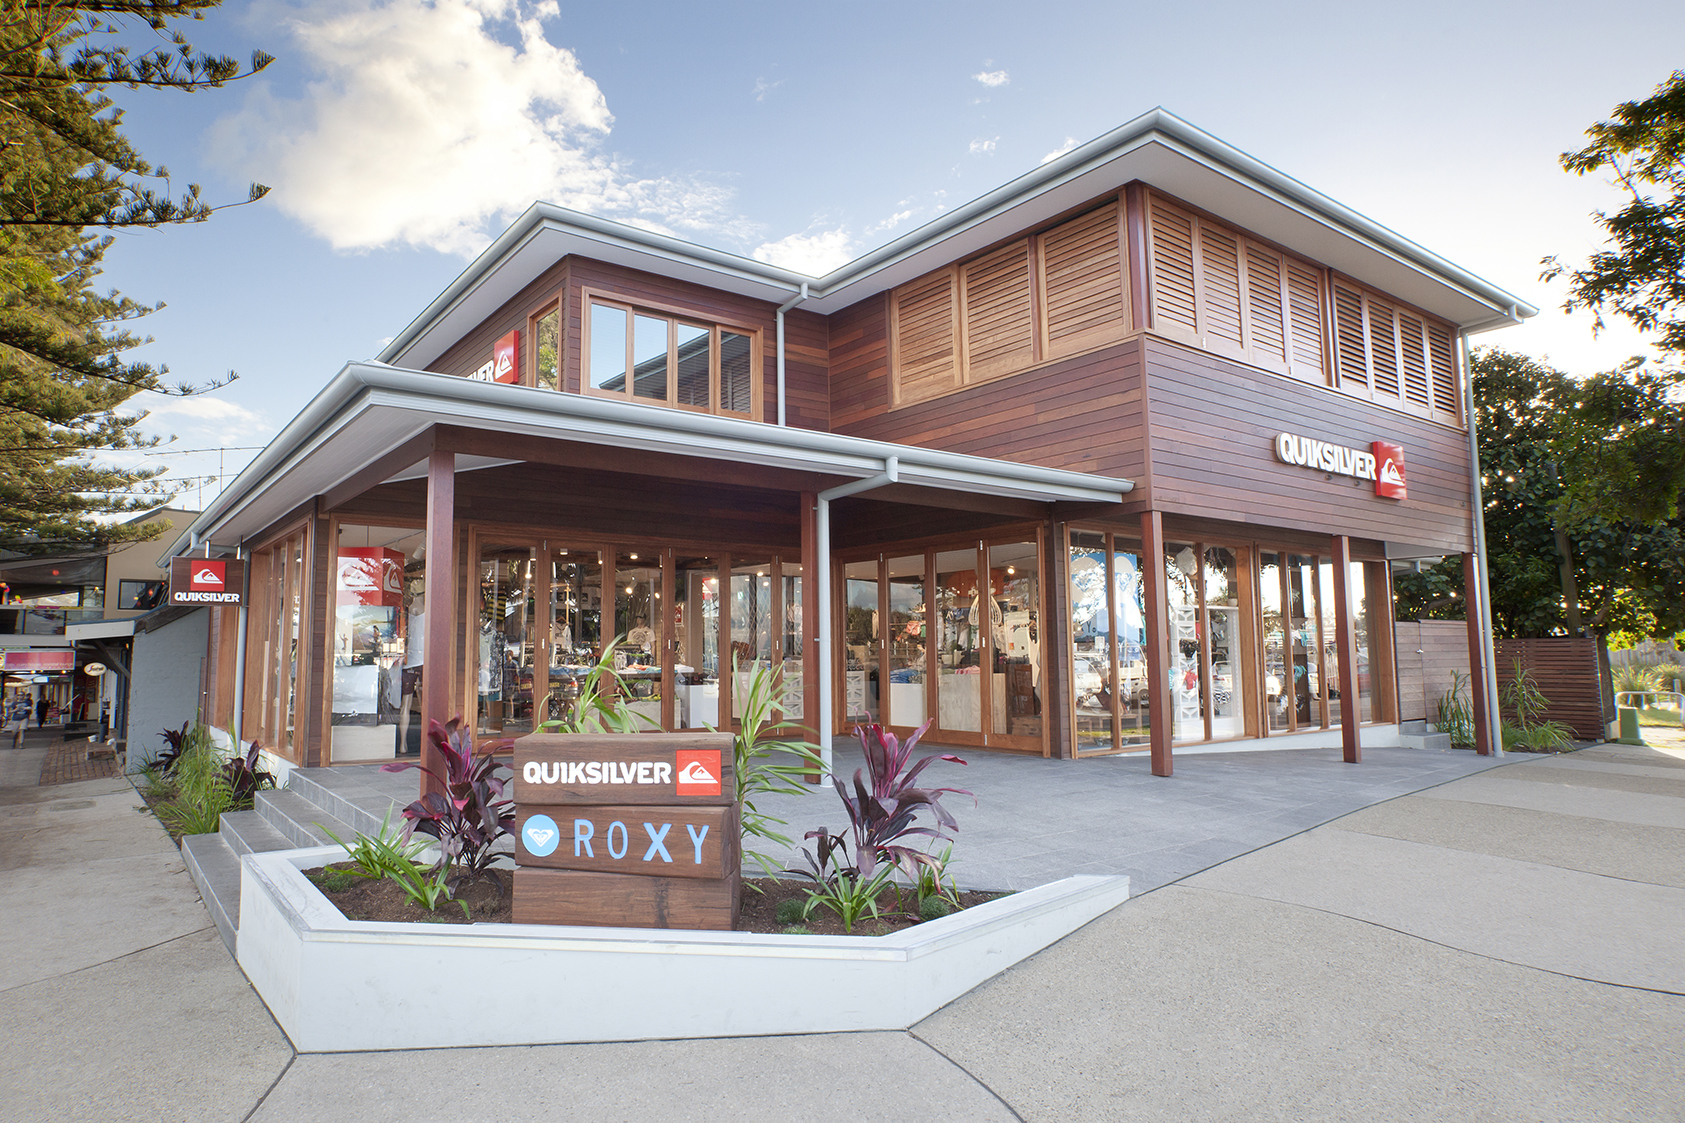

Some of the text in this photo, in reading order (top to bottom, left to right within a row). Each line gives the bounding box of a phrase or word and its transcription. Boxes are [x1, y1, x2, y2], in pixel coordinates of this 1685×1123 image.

[1276, 432, 1377, 481] QUIKSILVER
[174, 591, 240, 603] QUIKSILVER
[523, 761, 672, 784] QUIKSILVER
[574, 819, 710, 864] ROXY
